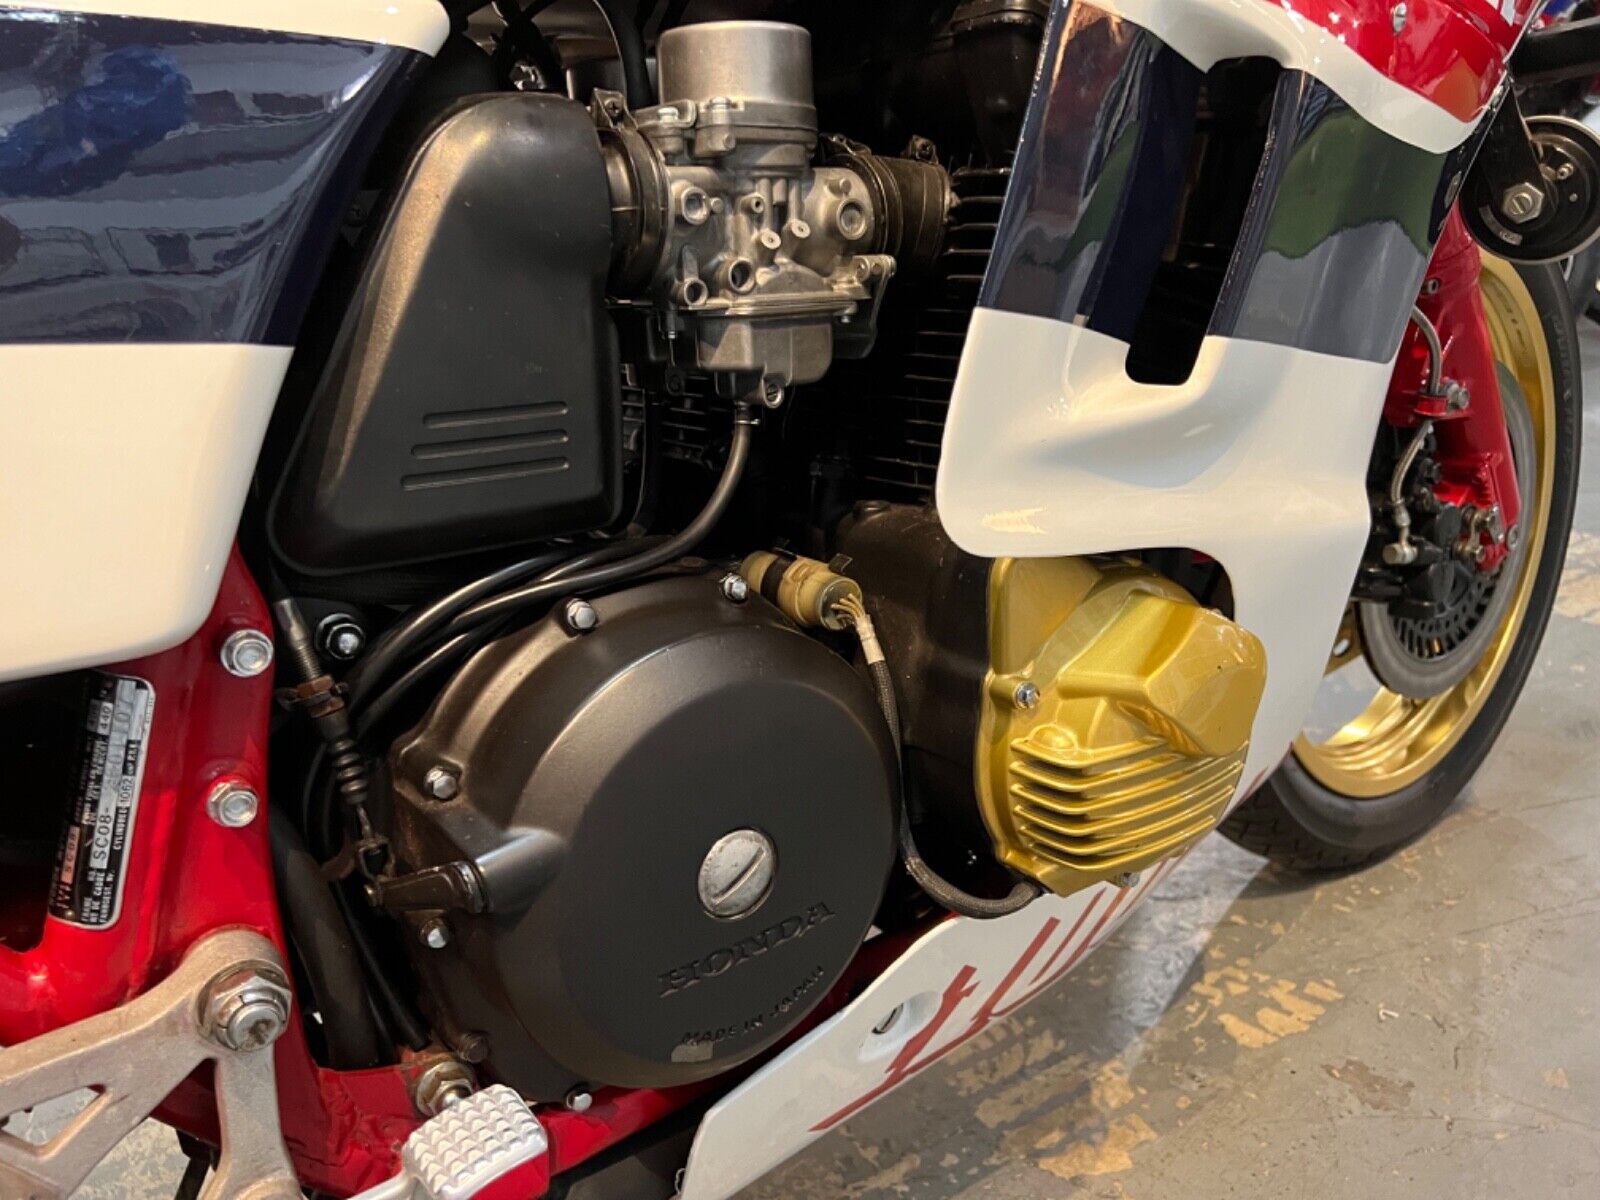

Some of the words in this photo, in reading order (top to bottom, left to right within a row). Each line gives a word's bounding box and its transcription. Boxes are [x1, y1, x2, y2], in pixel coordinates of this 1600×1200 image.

[657, 902, 836, 998] HONDA
[681, 1026, 738, 1047] MADE
[743, 1014, 764, 1033] IN
[768, 965, 825, 1018] JAPAN
